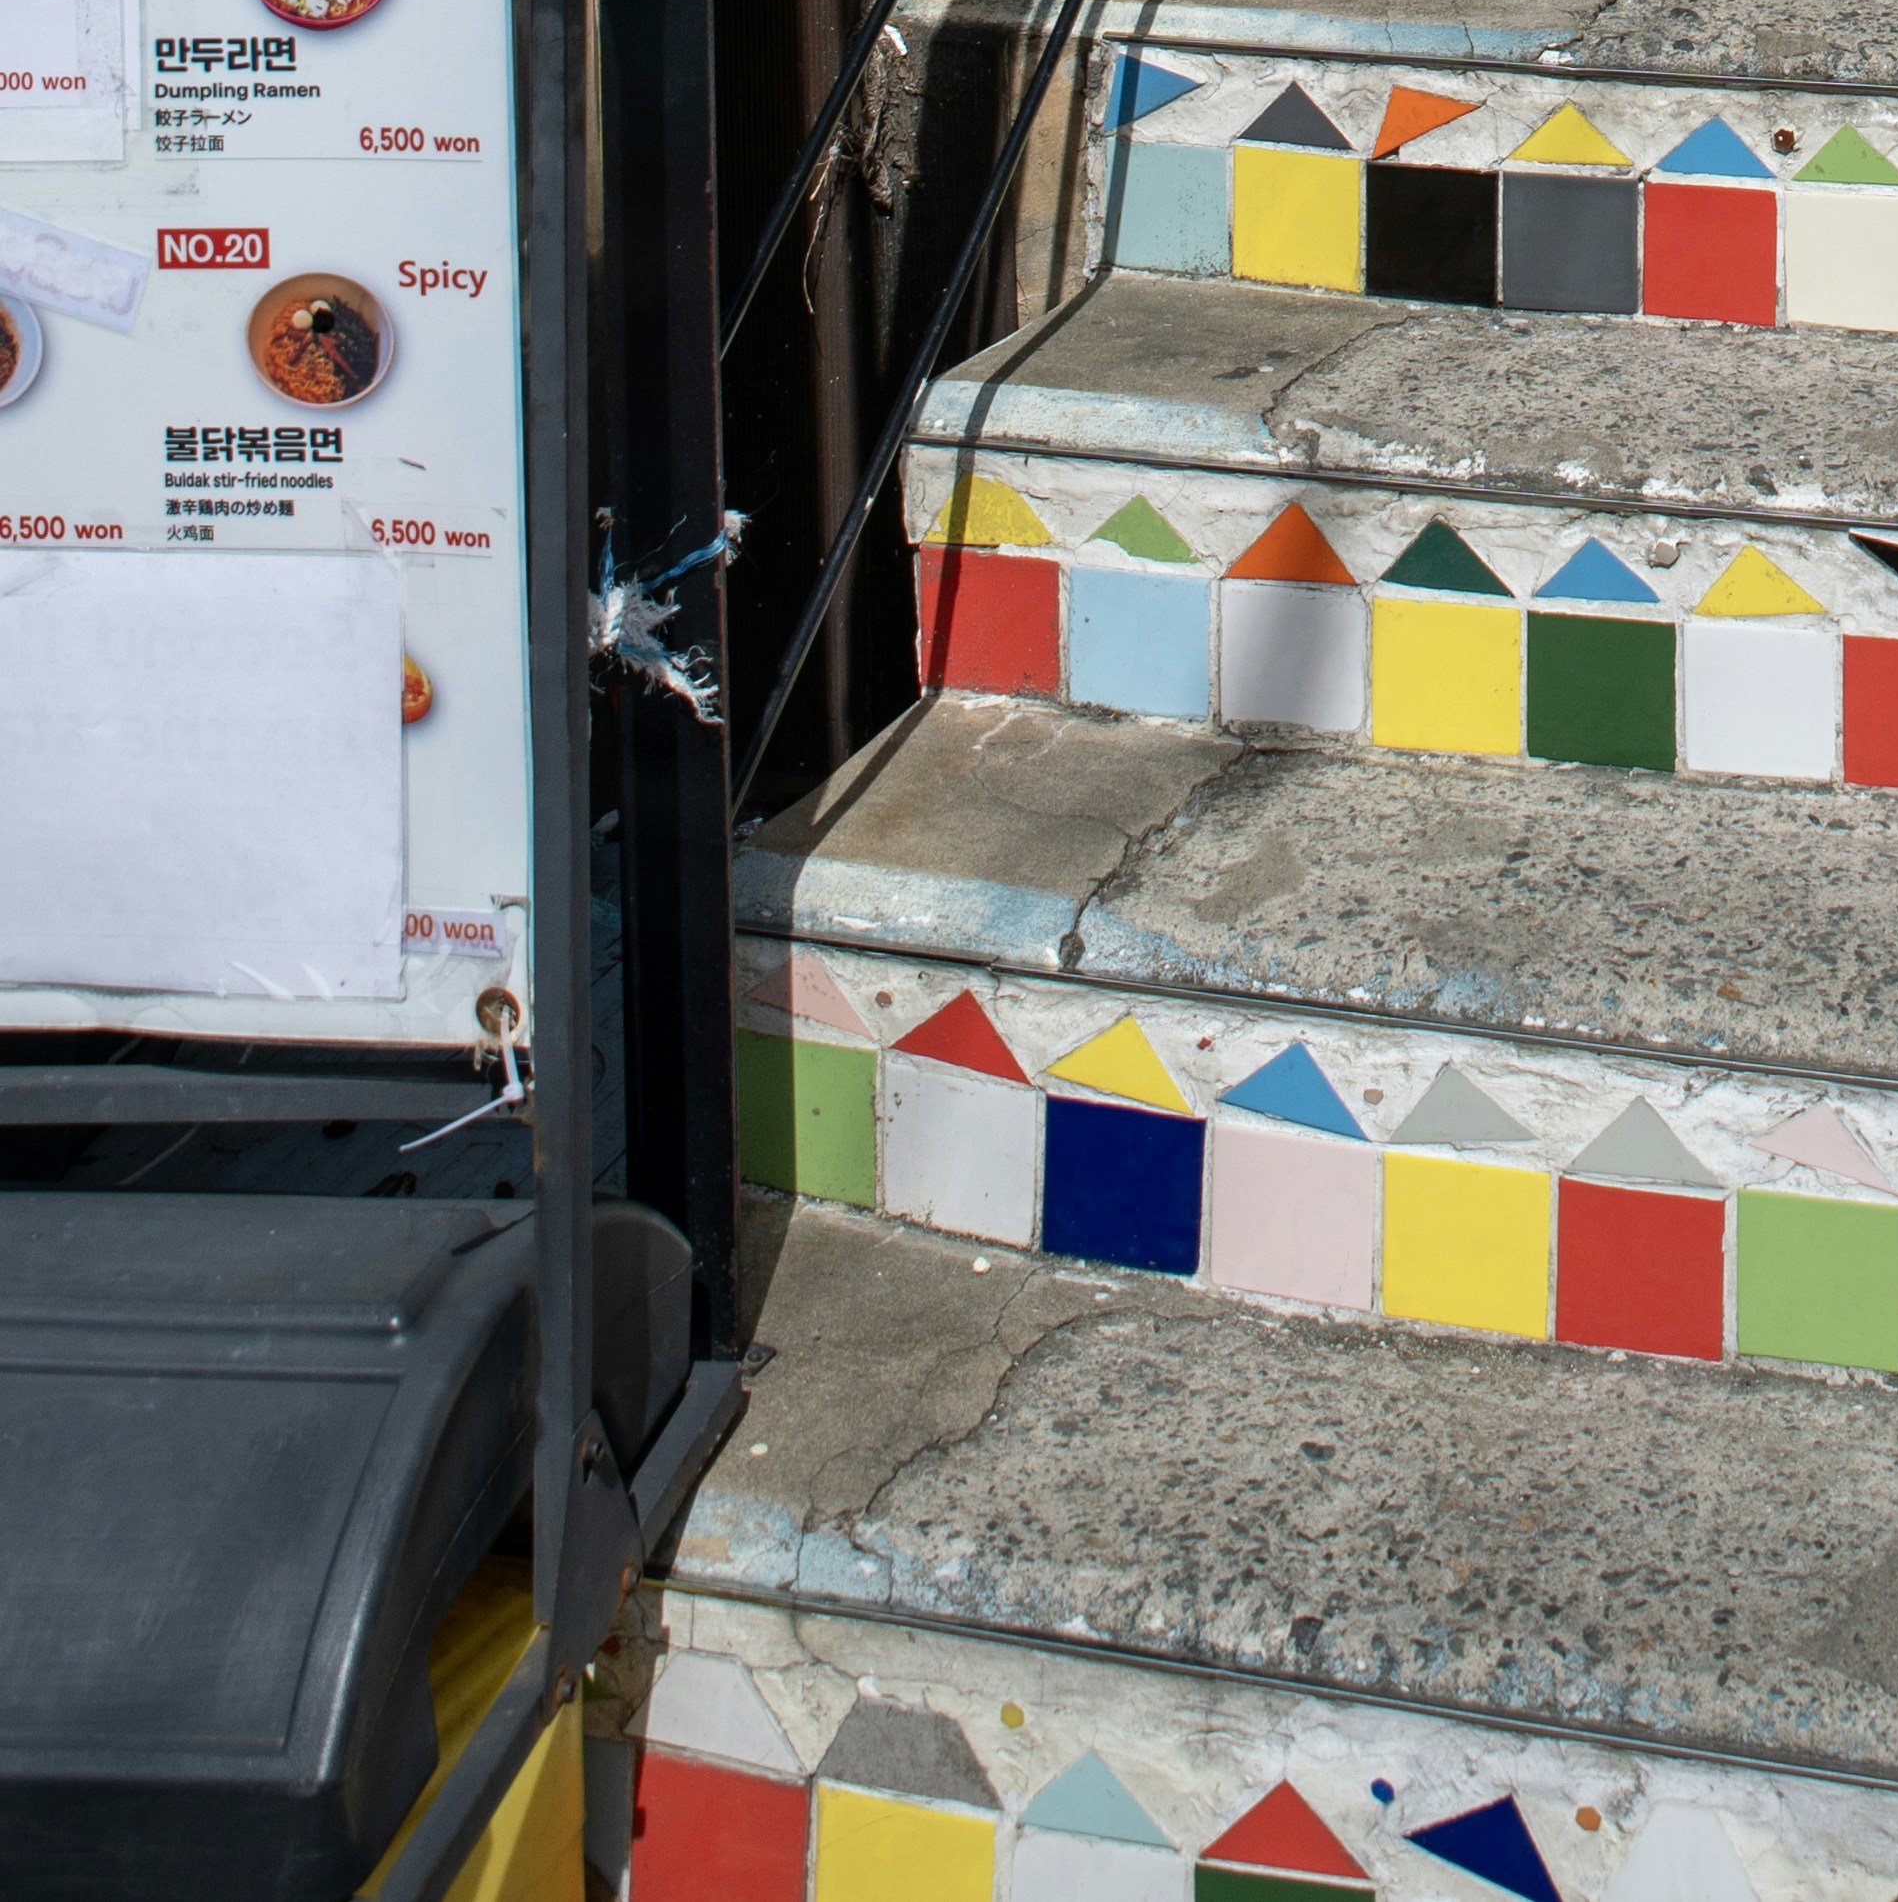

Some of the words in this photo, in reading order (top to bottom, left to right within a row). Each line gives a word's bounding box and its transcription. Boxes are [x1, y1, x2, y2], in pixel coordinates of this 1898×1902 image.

[156, 37, 297, 73] 만두라면
[42, 74, 87, 91] won
[155, 83, 248, 102] Dumpling
[253, 83, 320, 98] Ramen
[155, 109, 253, 126] 餃子ラーメン
[155, 135, 225, 152] 饺子拉面
[359, 127, 424, 154] 6,500
[434, 135, 480, 153] won
[164, 234, 263, 264] NO.20
[398, 260, 487, 297] Spicy
[166, 426, 344, 463] 불닭볶음면
[165, 474, 210, 488] Buldak
[214, 473, 277, 488] stir-fried
[281, 474, 333, 489] noodles
[0, 516, 65, 544] 6,500
[74, 523, 123, 540] won
[167, 525, 214, 541] 火鸡面
[371, 519, 435, 547] 6,500
[445, 529, 490, 547] won
[442, 920, 495, 943] won
